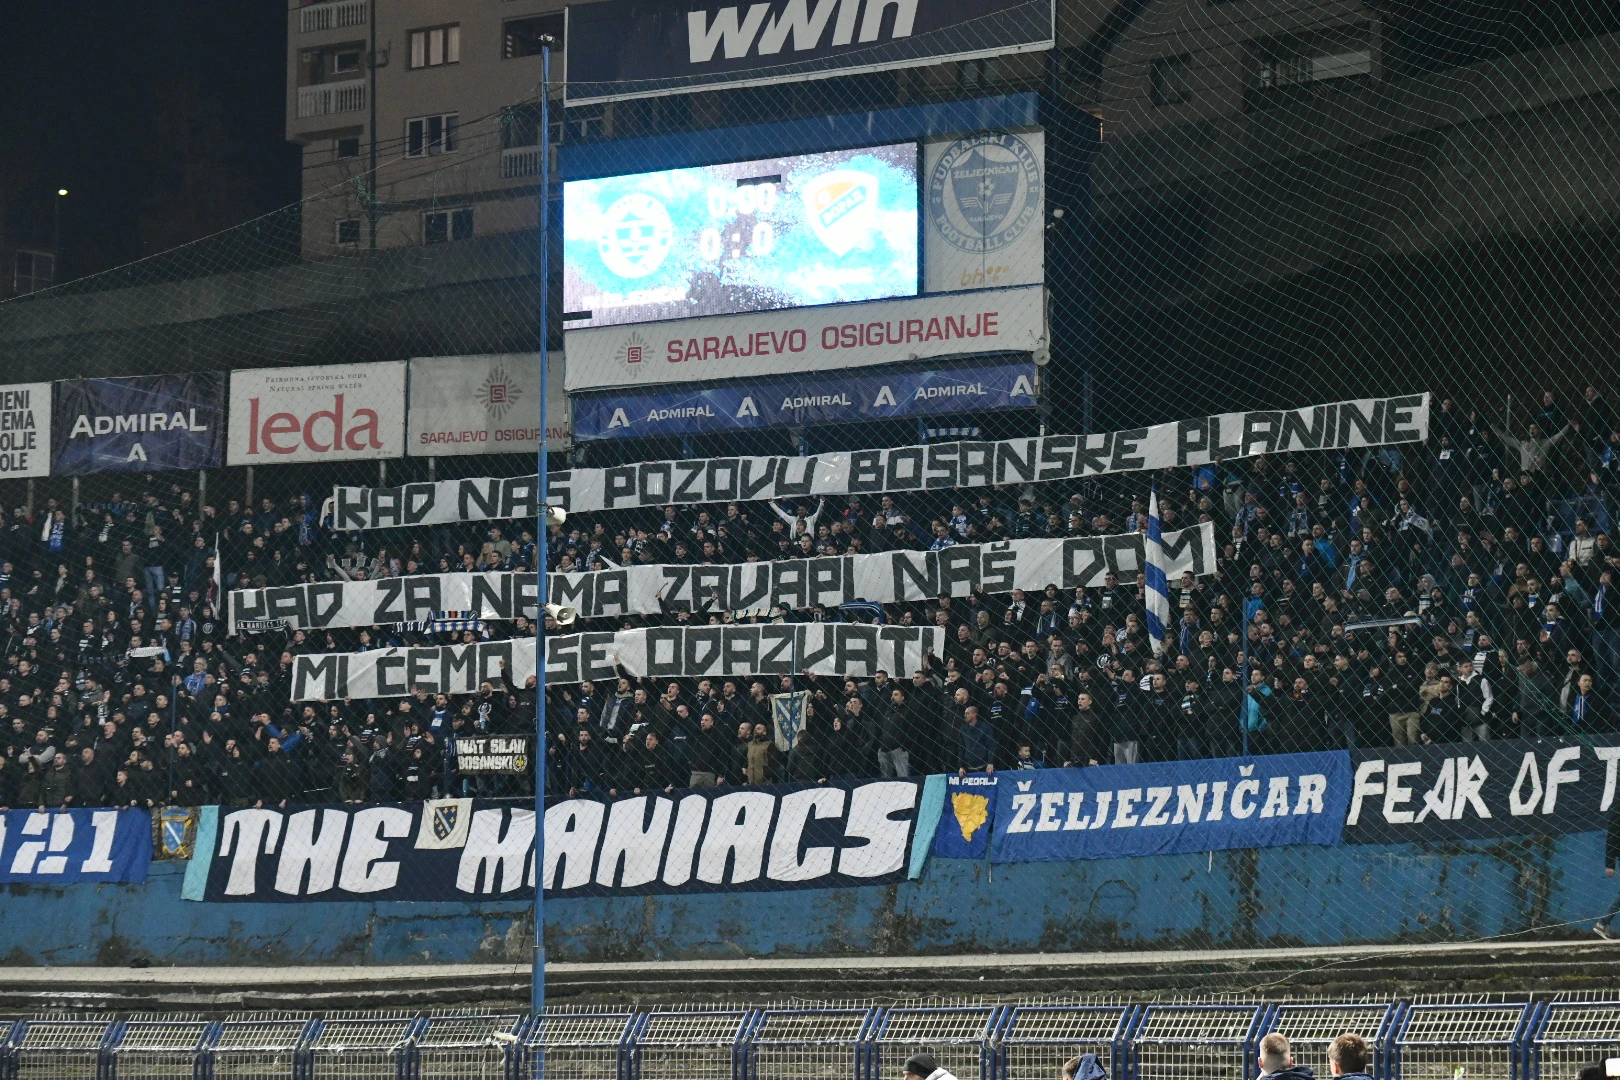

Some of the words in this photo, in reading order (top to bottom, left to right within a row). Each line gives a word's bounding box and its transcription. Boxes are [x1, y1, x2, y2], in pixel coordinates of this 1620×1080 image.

[1009, 138, 1039, 184] KLUB
[935, 213, 1004, 251] FOOTBALL
[1002, 204, 1036, 243] CLUB
[667, 328, 807, 363] SARAJEVO
[821, 312, 1000, 351] OSIGURANJE
[69, 407, 207, 439] ADMIRAL
[246, 393, 384, 455] leda
[647, 404, 715, 422] ADMIRAL
[781, 392, 852, 410] ADMIRAL
[914, 382, 987, 400] ADMIRAL
[337, 482, 436, 529] KAD
[458, 474, 571, 520] NAS
[604, 457, 812, 508] POZOVU
[848, 427, 1148, 491] BOSANSKE
[1178, 397, 1420, 465] PLANINE
[420, 430, 488, 444] SARAJEVO
[374, 576, 442, 624] ZA
[471, 570, 629, 619] NAMA
[891, 542, 1017, 602] NAŠ
[1062, 526, 1205, 586] DOM
[294, 655, 349, 701] MI
[376, 646, 513, 696] ĆEMO
[547, 631, 614, 682] SE
[645, 623, 934, 682] ODAZVATI
[457, 755, 514, 770] BOSANSKI
[1345, 753, 1494, 826] FEAR
[1508, 745, 1581, 817] OF
[1006, 764, 1326, 834] ŽELJEZNIČAR
[218, 806, 412, 896] THE
[455, 782, 918, 894] MANIACS
